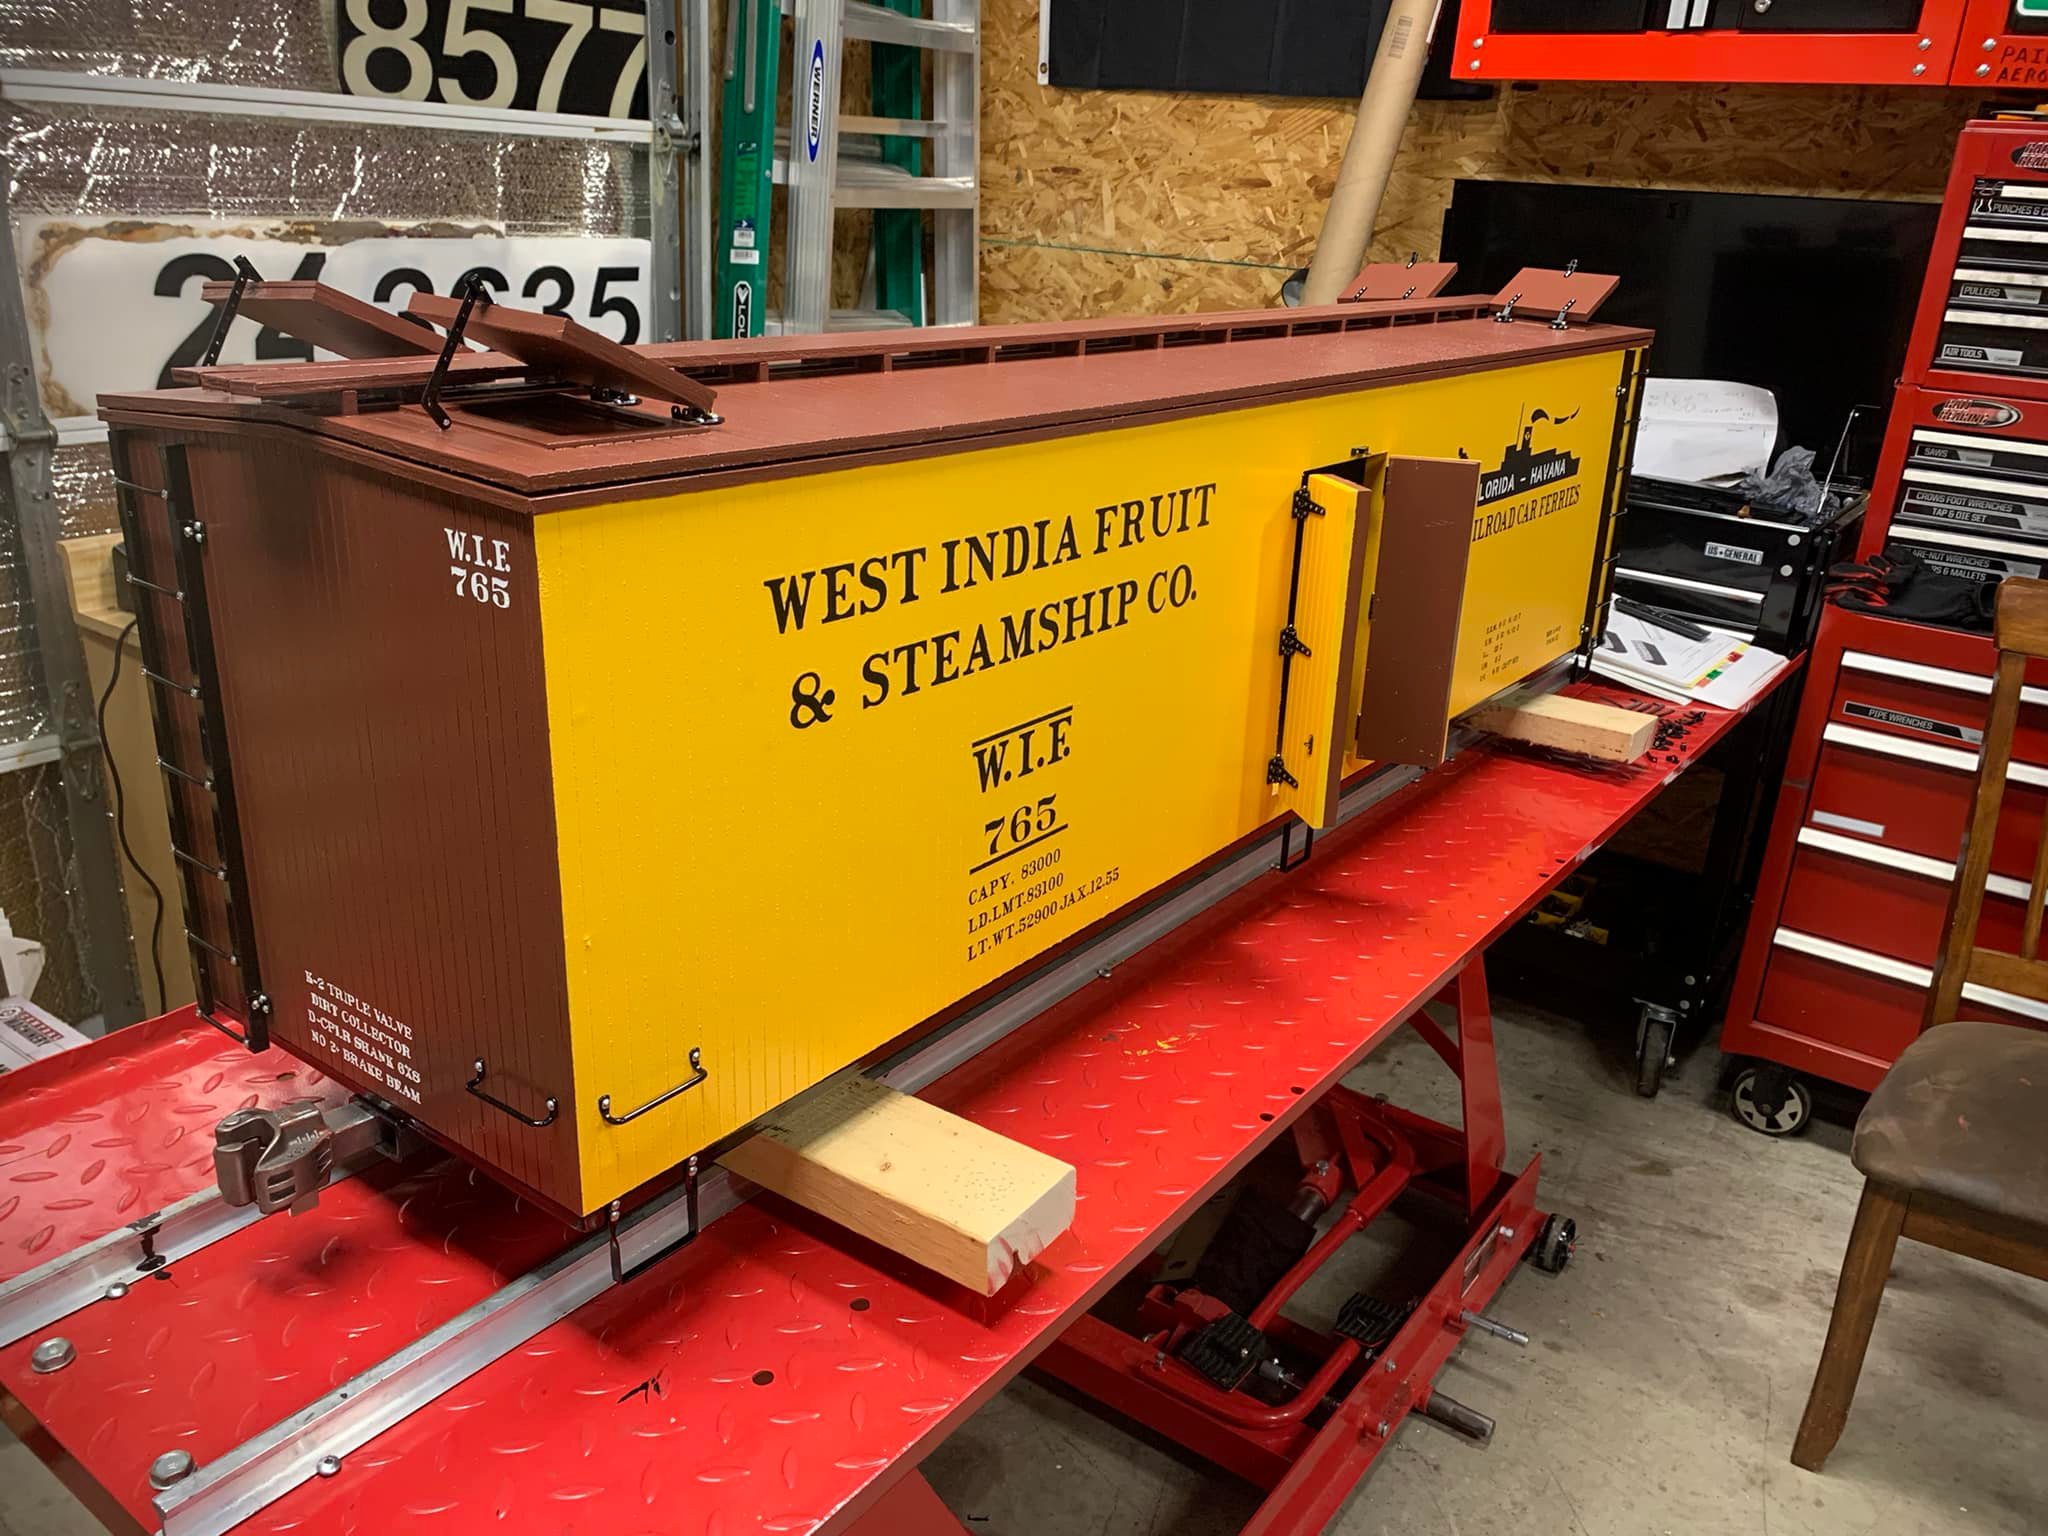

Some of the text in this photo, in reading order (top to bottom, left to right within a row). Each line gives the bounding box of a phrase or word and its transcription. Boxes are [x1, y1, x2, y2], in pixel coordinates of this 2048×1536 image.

[343, 0, 646, 118] 8577
[811, 66, 821, 138] WERNER
[1993, 203, 2032, 216] PUNCHES
[2033, 206, 2041, 216] &
[1963, 285, 2001, 298] PULLERS
[1944, 346, 1959, 356] AIR
[1959, 348, 1984, 359] TOOLS
[1530, 458, 1566, 485] HAVANA
[1923, 447, 1949, 458] SAWS
[1517, 498, 1538, 525] CAR
[1538, 484, 1581, 517] FERRIES
[1916, 491, 2014, 513] CROWS FOOT WRENCHES
[1932, 507, 1988, 523] TAP & DIE SET
[763, 482, 1217, 635] WEST INDIA FRUIT
[1942, 566, 1950, 576] &
[1950, 568, 1987, 582] MALLETS
[1945, 552, 1991, 568] WRENCHES
[450, 565, 511, 609] 765
[790, 563, 1198, 730] & STEAMSHIP CO.
[1868, 708, 1934, 731] PIPE WRENCHES
[972, 714, 1073, 793] W.I.F.
[984, 793, 1057, 856] 765
[968, 848, 1061, 906] CAPY. 83000
[304, 969, 413, 1041] K-2 TRIPLE VALVE
[310, 991, 412, 1060] DIRT COLLECTOR
[307, 1008, 352, 1044] D-CPLR
[353, 1036, 395, 1070] SHANK
[310, 1029, 327, 1048] NO
[342, 1047, 384, 1082] BRAKE
[385, 1073, 422, 1105] BEAM
